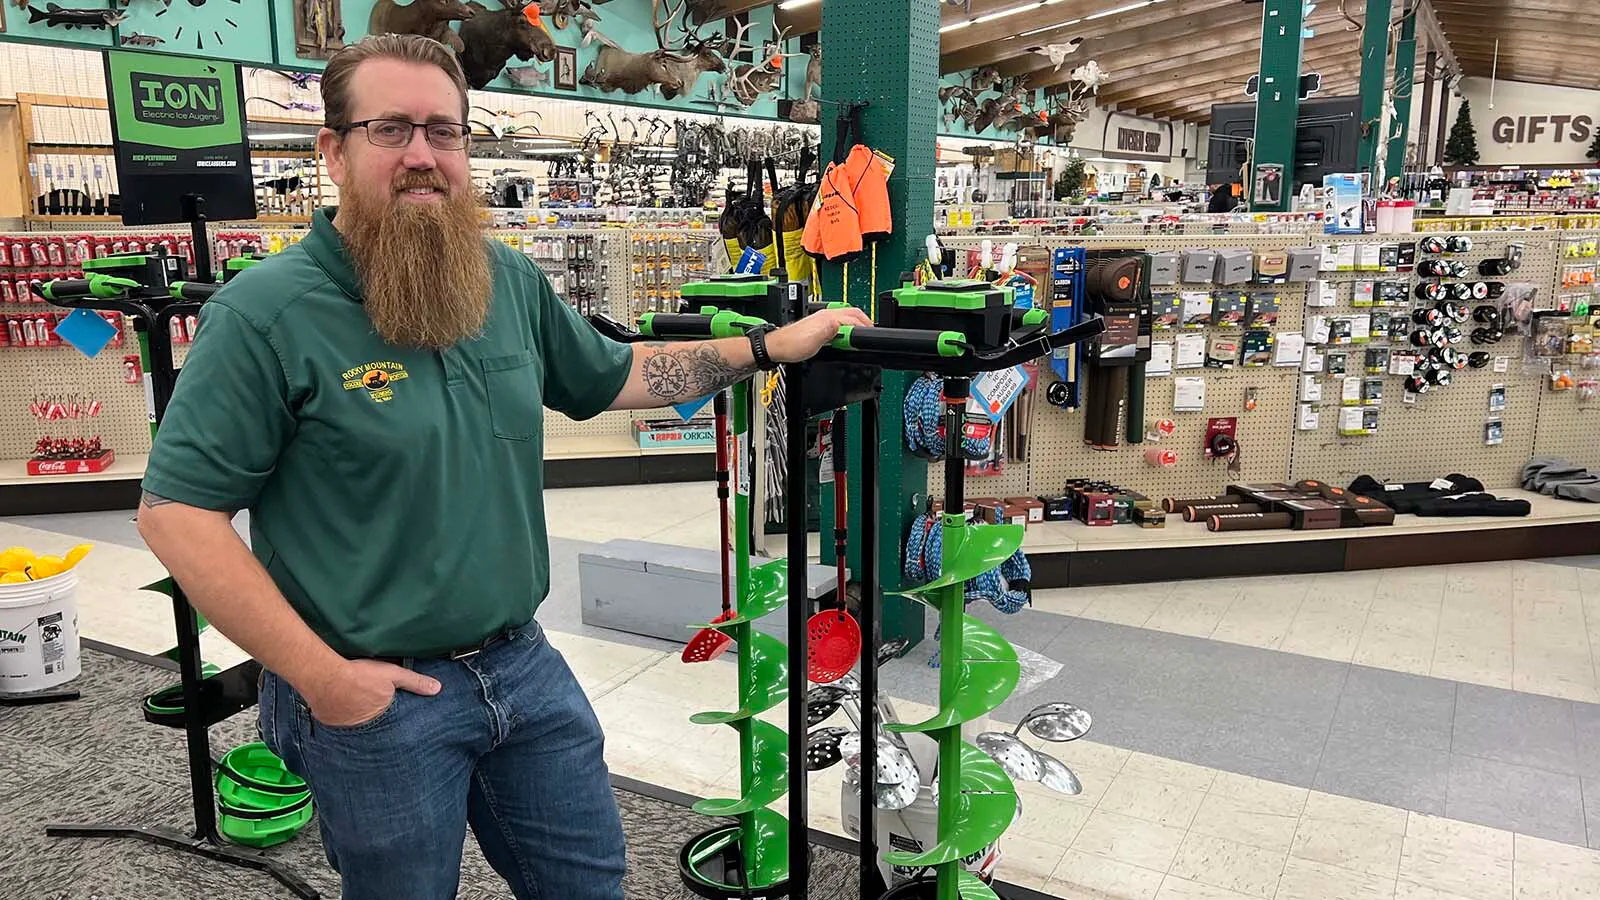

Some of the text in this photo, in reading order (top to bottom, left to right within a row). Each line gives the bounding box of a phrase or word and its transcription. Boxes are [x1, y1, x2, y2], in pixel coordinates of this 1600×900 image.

[139, 80, 217, 111] ION
[142, 111, 217, 122] Electric Ice Augers
[1492, 115, 1593, 144] GIFTS
[341, 361, 404, 381] ROCKY MOUNTAIN
[996, 377, 1013, 400] AUGER
